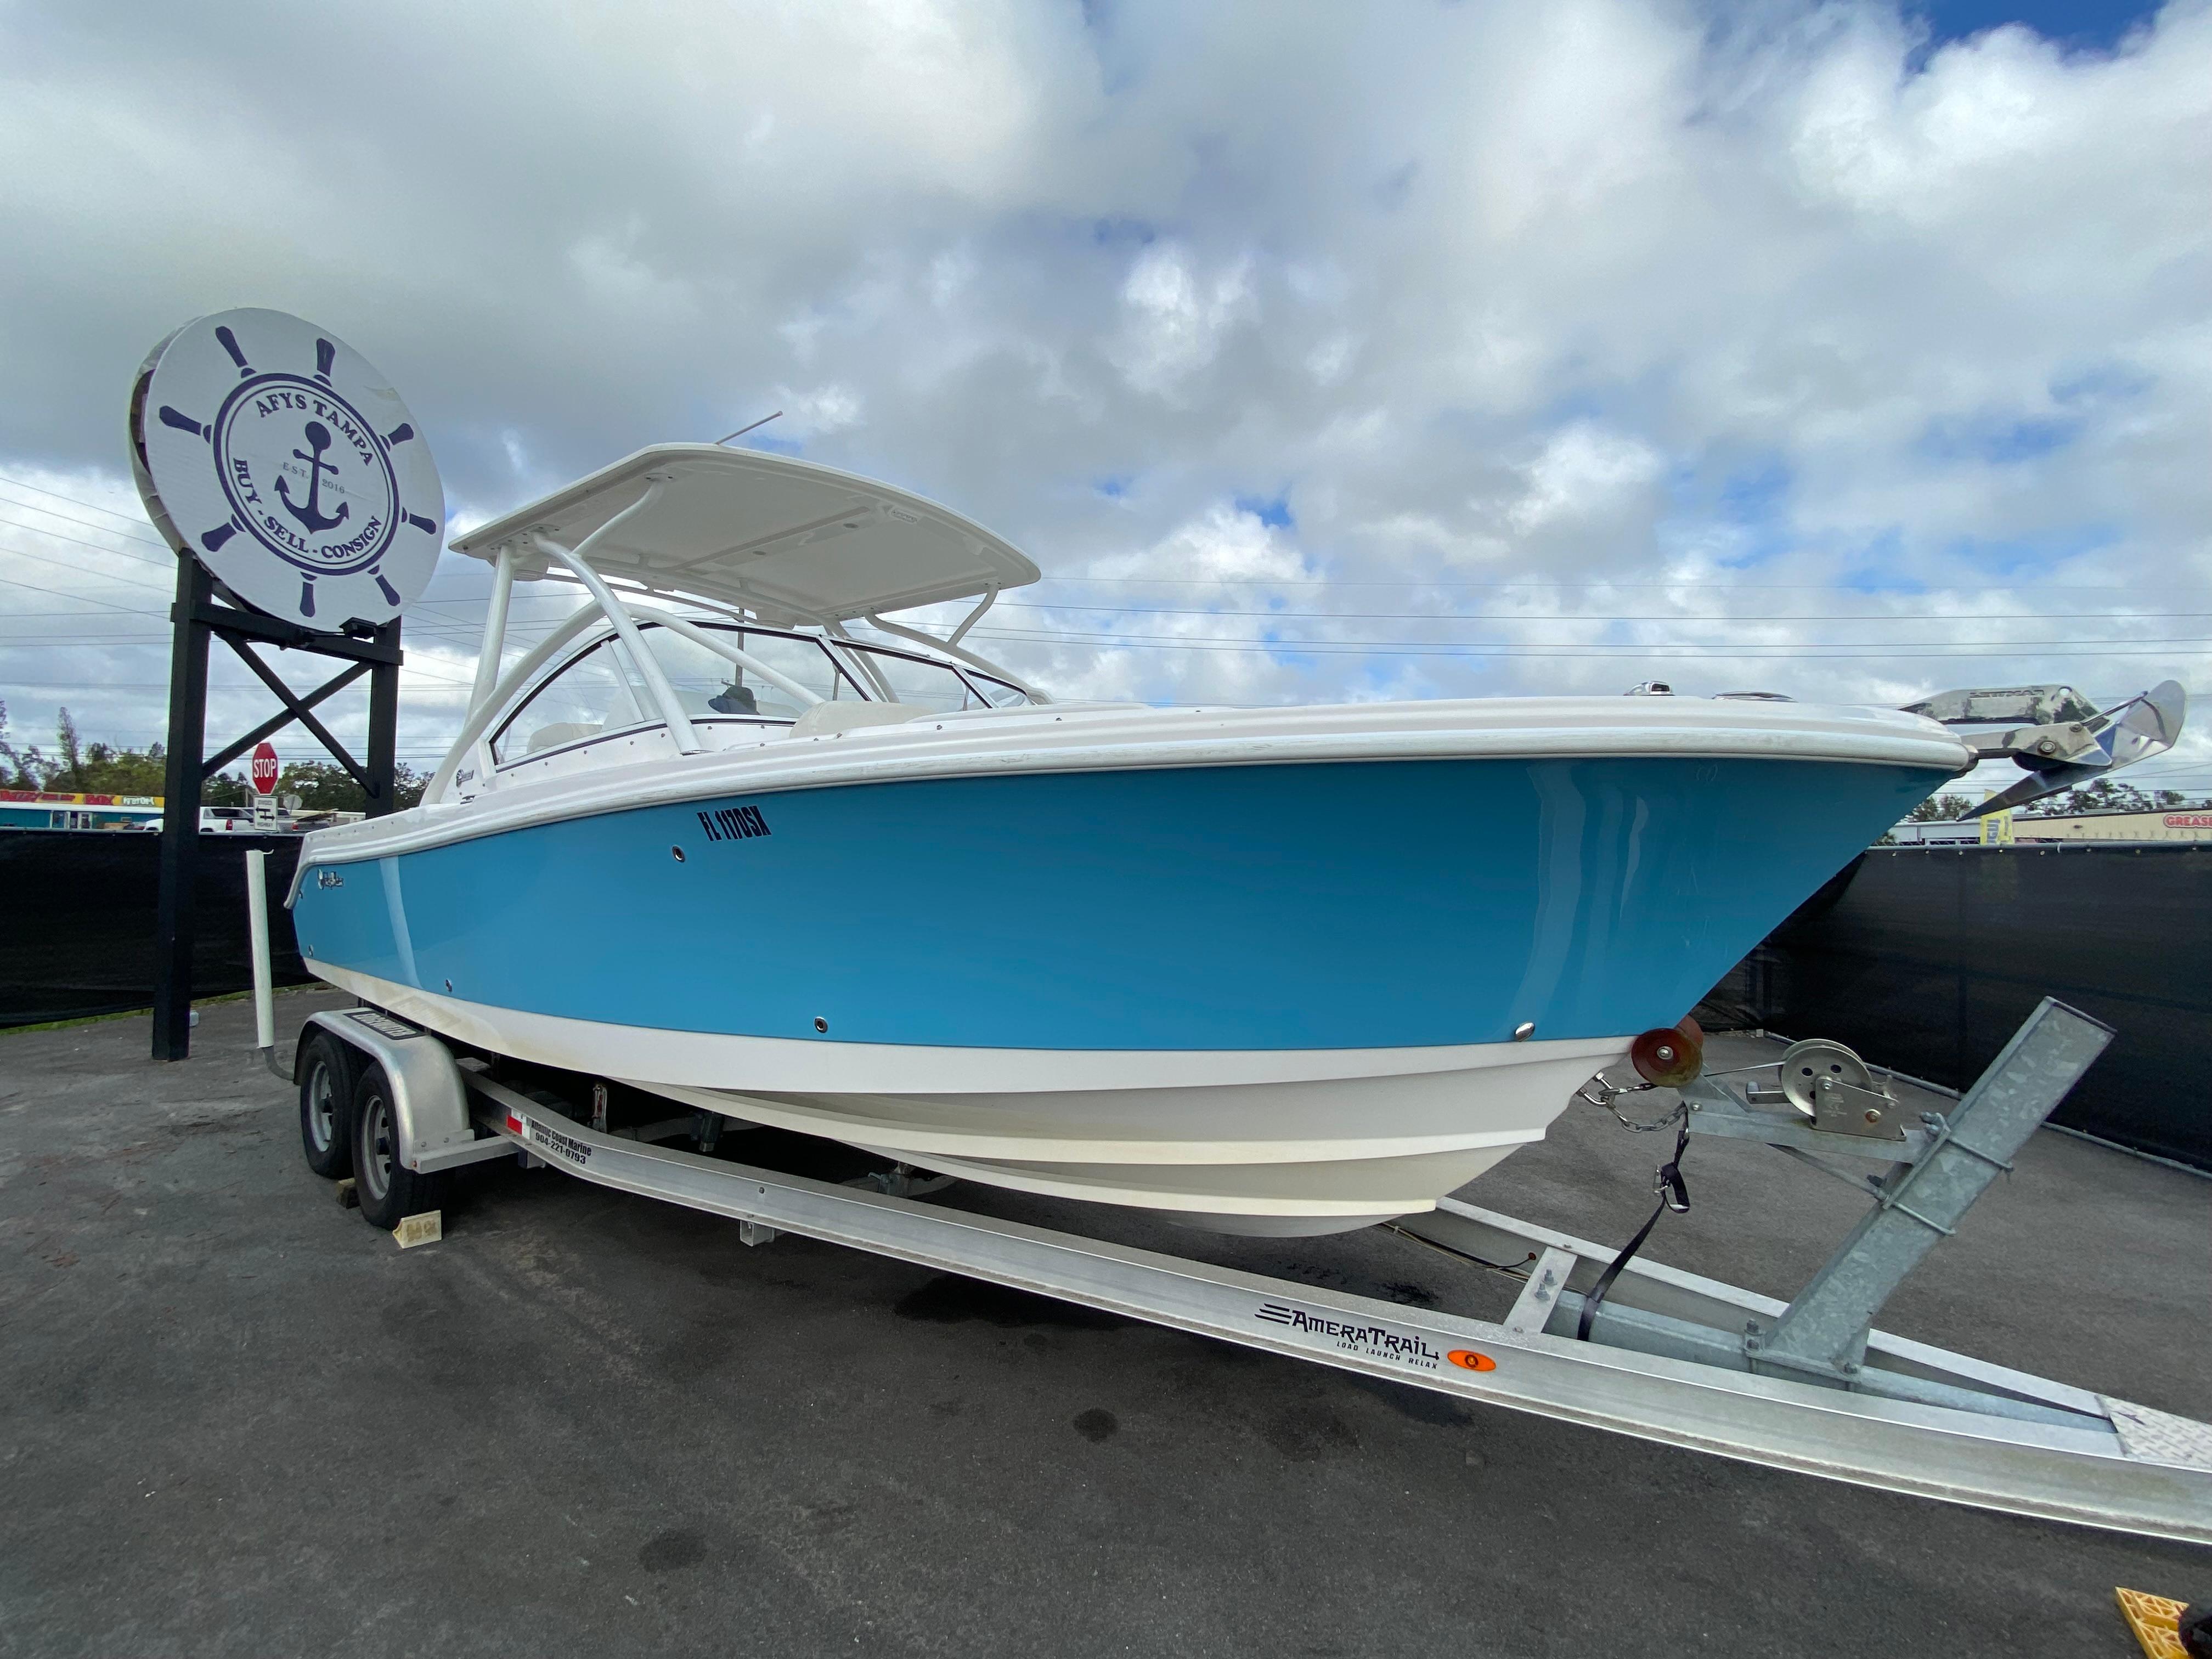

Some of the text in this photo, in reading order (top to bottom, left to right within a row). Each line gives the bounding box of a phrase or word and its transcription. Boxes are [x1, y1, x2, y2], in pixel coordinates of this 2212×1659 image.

[256, 392, 374, 466] AFYS TAMPA
[283, 462, 308, 479] EST.
[321, 479, 346, 494] 2016
[233, 458, 263, 504] BUY
[264, 516, 309, 554] SELL
[321, 516, 382, 559] CONSIGN
[253, 758, 276, 778] STOP
[697, 805, 772, 842] FL 1170SX
[531, 1120, 592, 1156] Atlantic Coast Marine
[535, 1132, 586, 1164] 904-221-0793
[1336, 1341, 1437, 1370] LOAD LAUNCH RELAX
